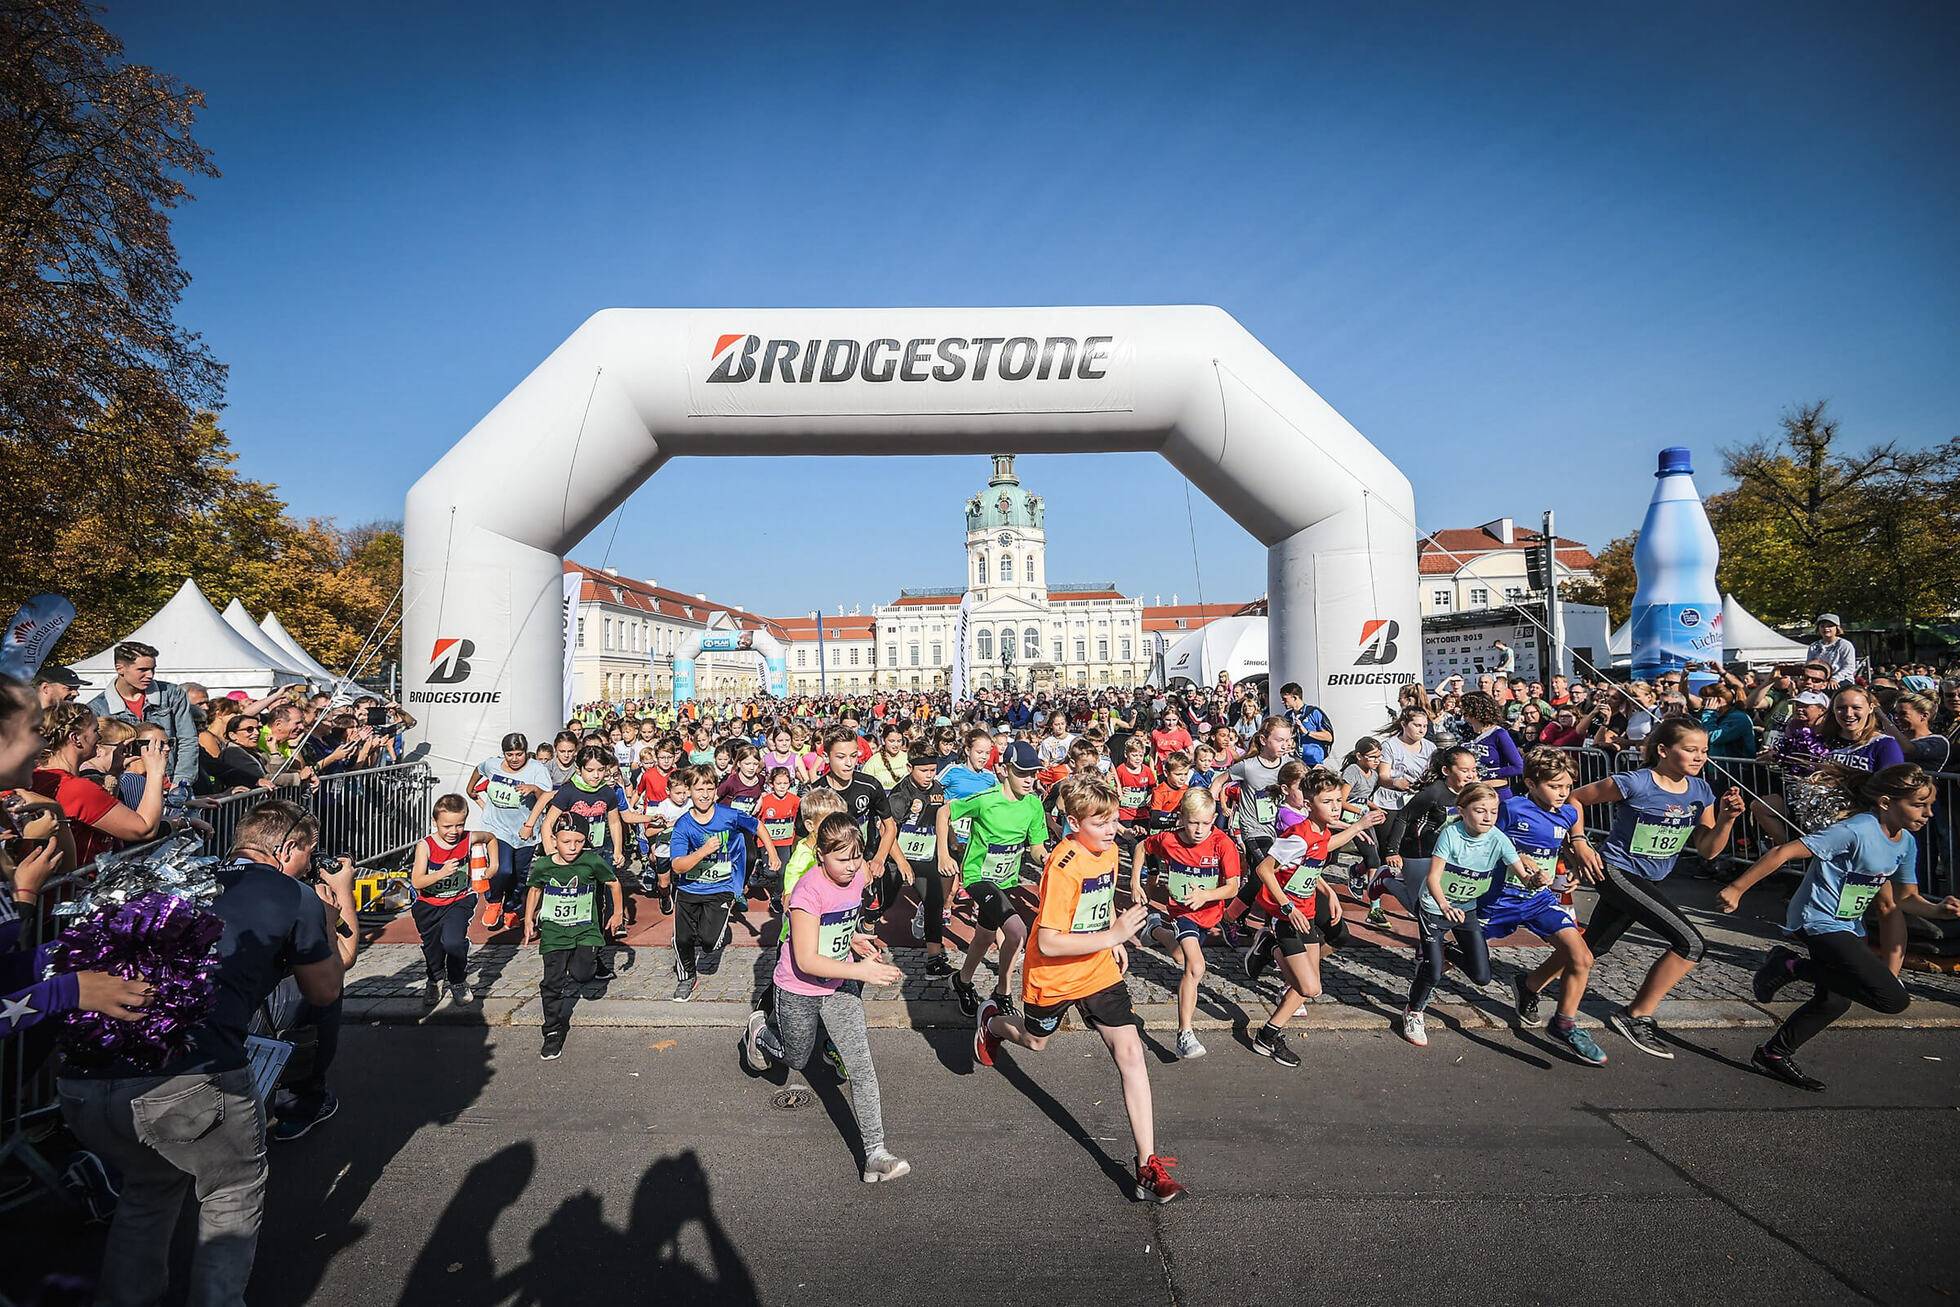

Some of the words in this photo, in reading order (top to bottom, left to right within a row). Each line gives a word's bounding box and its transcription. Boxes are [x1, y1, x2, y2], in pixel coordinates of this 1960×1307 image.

[705, 333, 1113, 384] BRIDGESTONE
[24, 614, 65, 664] Lichtenauer
[1425, 635, 1461, 645] OKTOBER
[1464, 633, 1483, 642] 2019
[1327, 672, 1416, 685] BRIDGESTONE
[409, 691, 502, 704] BRIDGESTONE
[495, 790, 511, 801] 144
[771, 828, 786, 836] 157
[907, 841, 925, 853] 181
[1651, 835, 1679, 850] 182
[699, 868, 719, 880] 148
[1448, 882, 1477, 897] 612
[554, 903, 578, 918] 531
